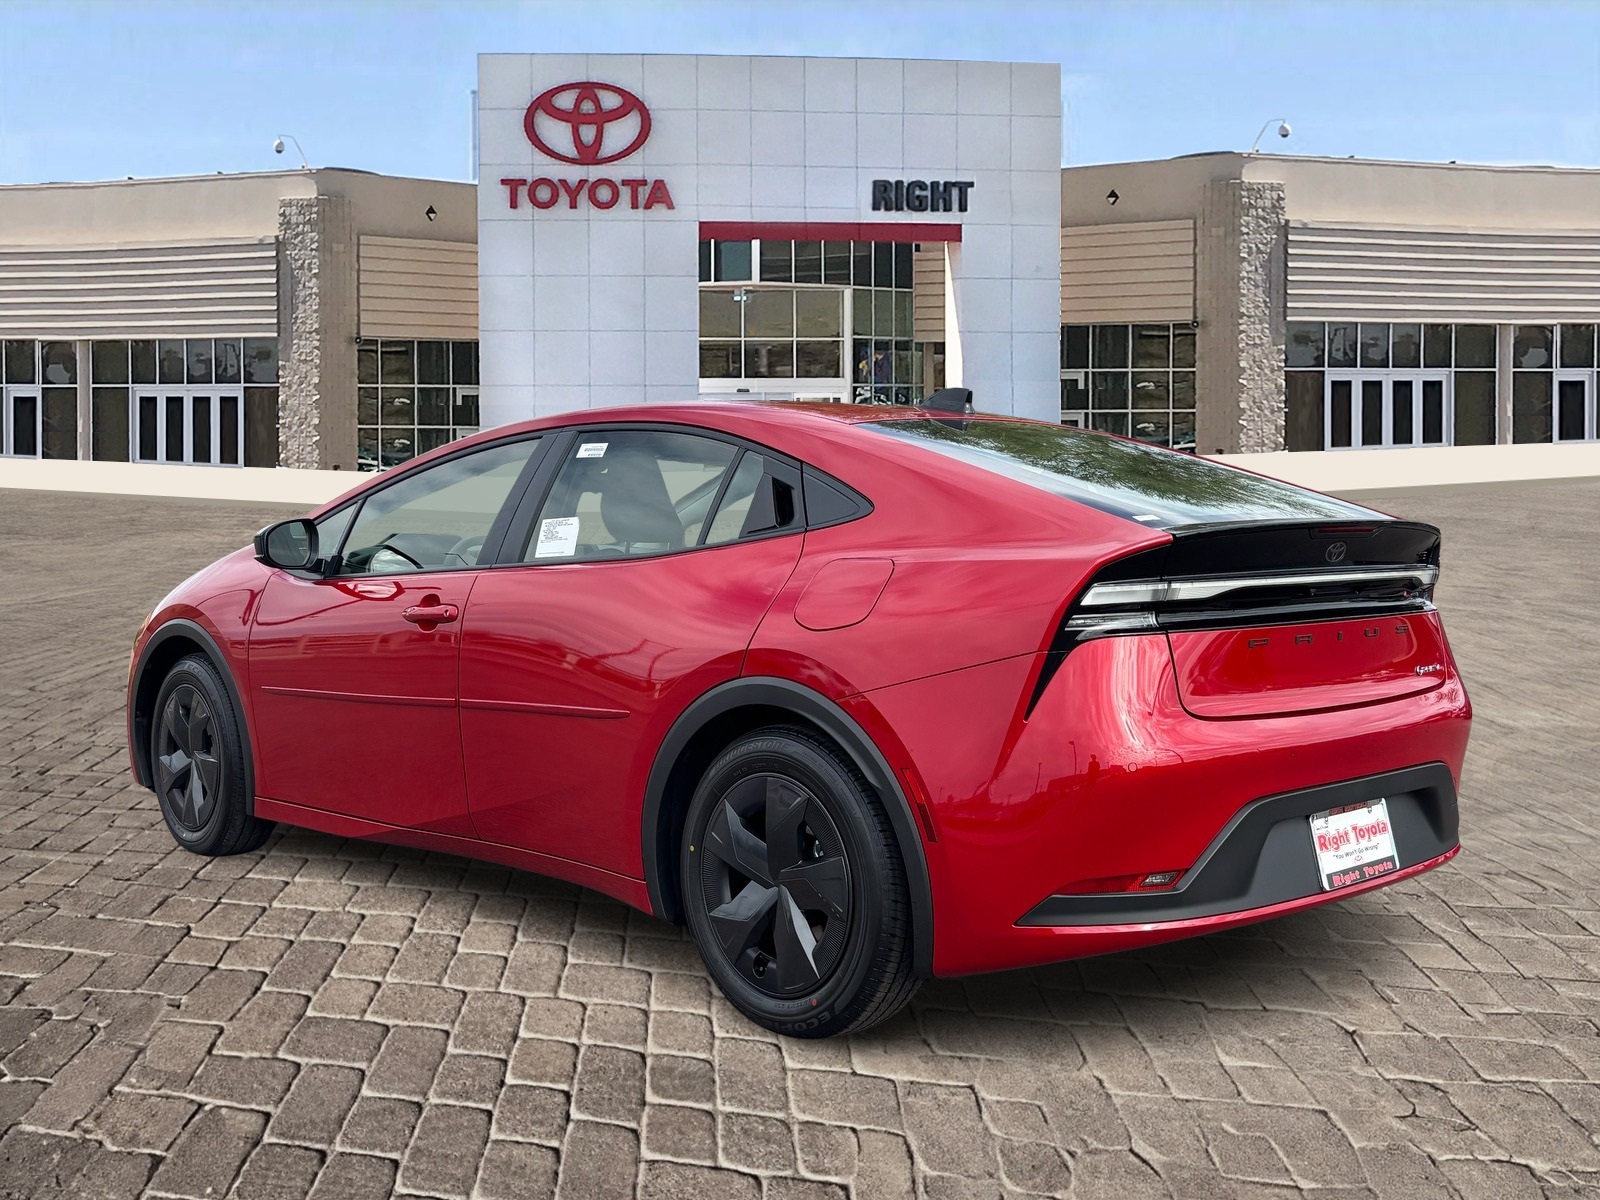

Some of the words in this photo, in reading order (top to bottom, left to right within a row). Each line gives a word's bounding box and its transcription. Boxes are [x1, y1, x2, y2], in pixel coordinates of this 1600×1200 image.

[500, 178, 675, 210] TOYOTA
[872, 180, 975, 212] RIGHT
[1248, 624, 1409, 648] PRIUS
[1317, 828, 1350, 852] Right
[1351, 820, 1388, 844] Toyota
[1332, 870, 1360, 887] Right
[1363, 861, 1393, 877] Toyota
